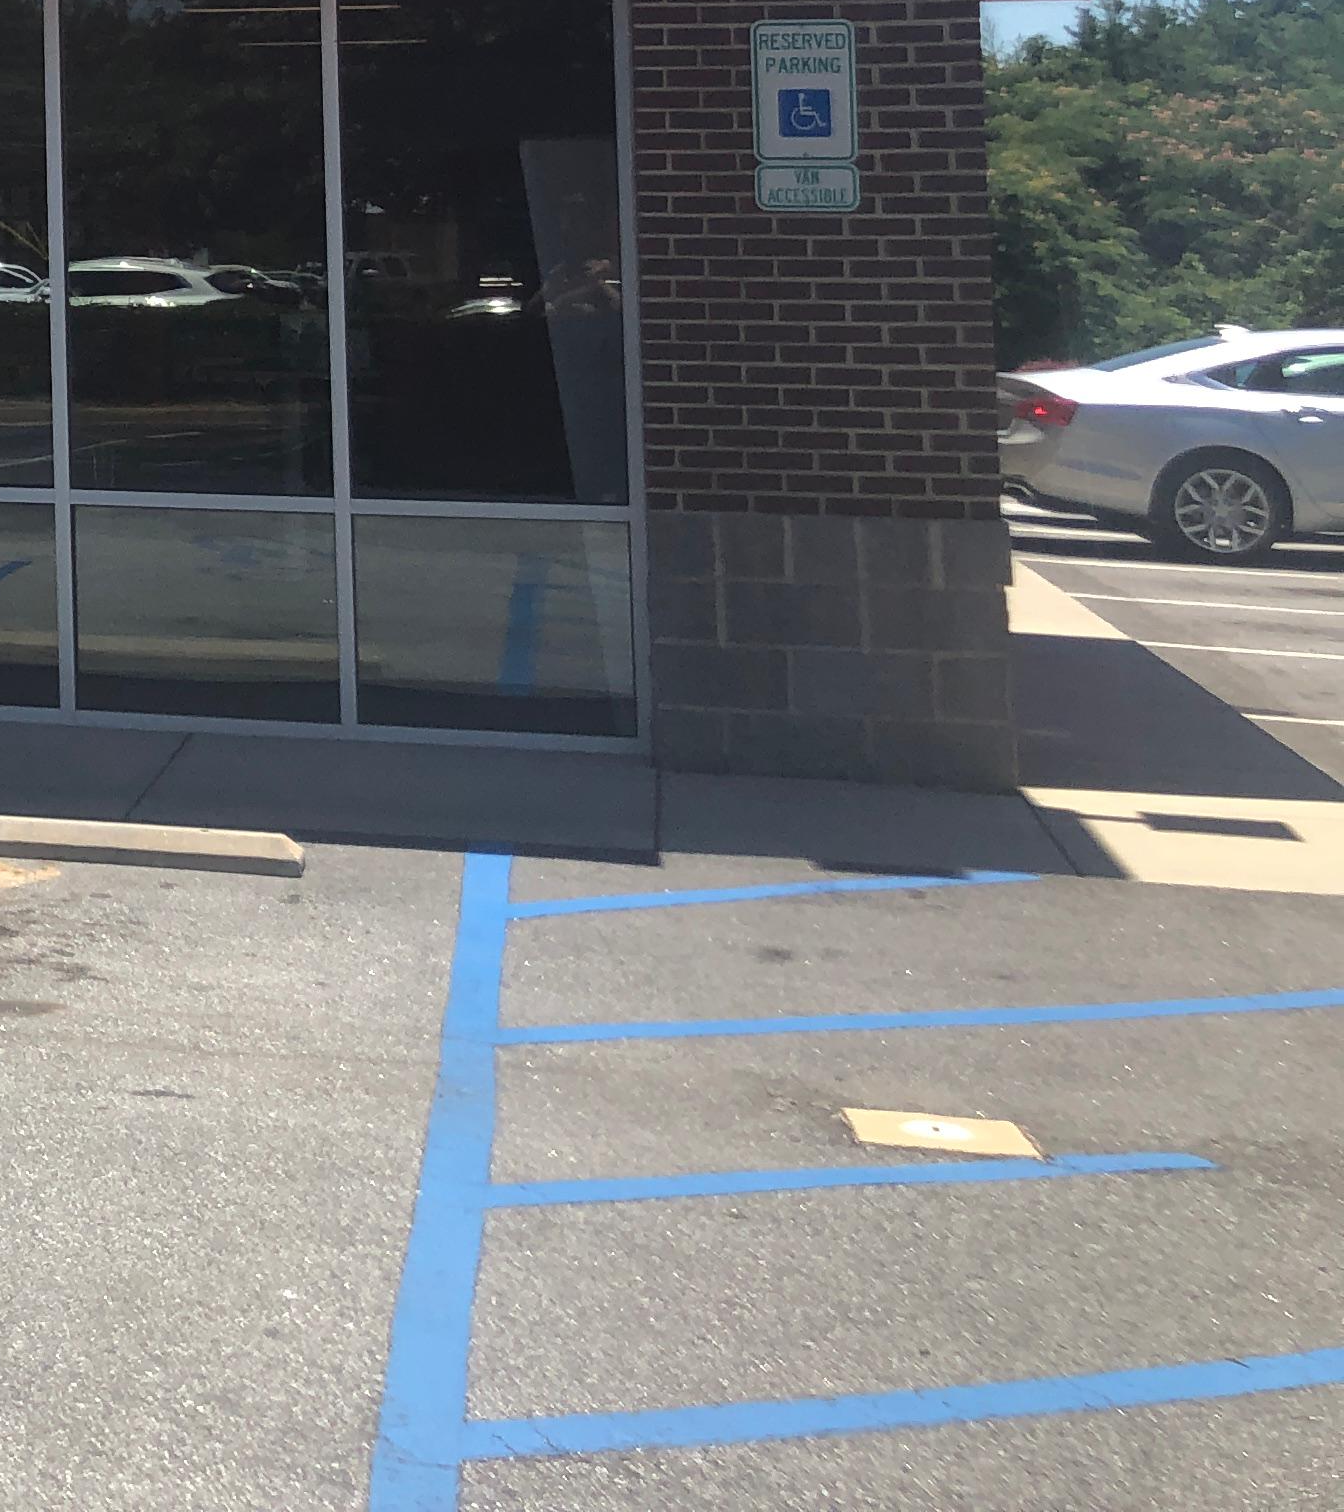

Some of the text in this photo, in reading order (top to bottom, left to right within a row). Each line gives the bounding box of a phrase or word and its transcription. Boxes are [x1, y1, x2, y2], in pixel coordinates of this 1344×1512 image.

[759, 33, 846, 50] RESERVED
[766, 57, 841, 74] PARKING
[794, 170, 820, 185] VAN
[768, 189, 848, 204] ACCESSIBLE
